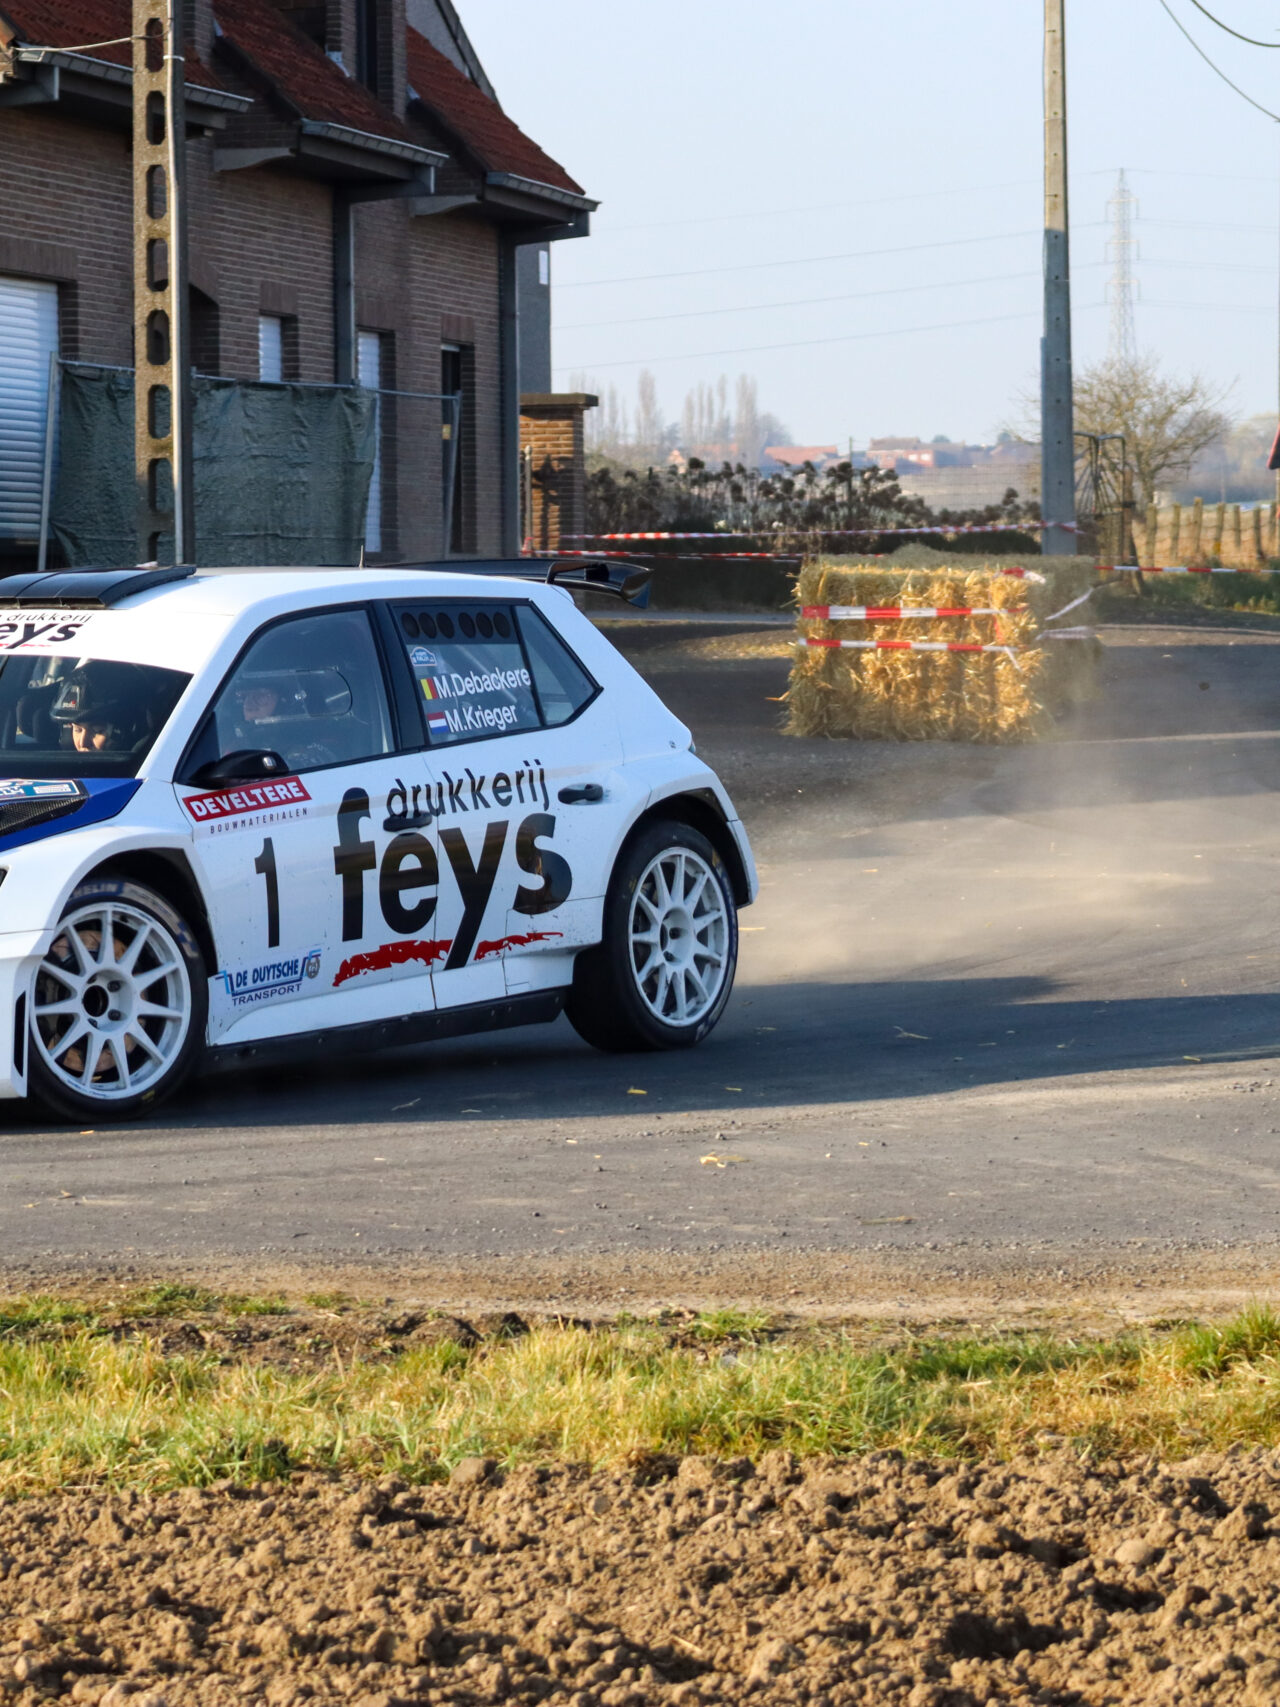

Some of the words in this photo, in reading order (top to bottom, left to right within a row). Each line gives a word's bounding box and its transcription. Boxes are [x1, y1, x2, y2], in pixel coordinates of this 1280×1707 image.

[6, 613, 95, 623] drukkerij
[433, 667, 531, 699] M.Debackere
[444, 704, 518, 733] M.Krieger
[189, 782, 306, 817] DEVELTERE
[386, 758, 550, 817] drukkerij
[210, 808, 308, 834] BOUWMATERIALEN
[254, 836, 280, 948] 1
[333, 787, 573, 970] feys
[235, 970, 248, 988] DE
[253, 959, 299, 984] DUYTSCHE
[232, 983, 303, 1007] TRANSPORT
